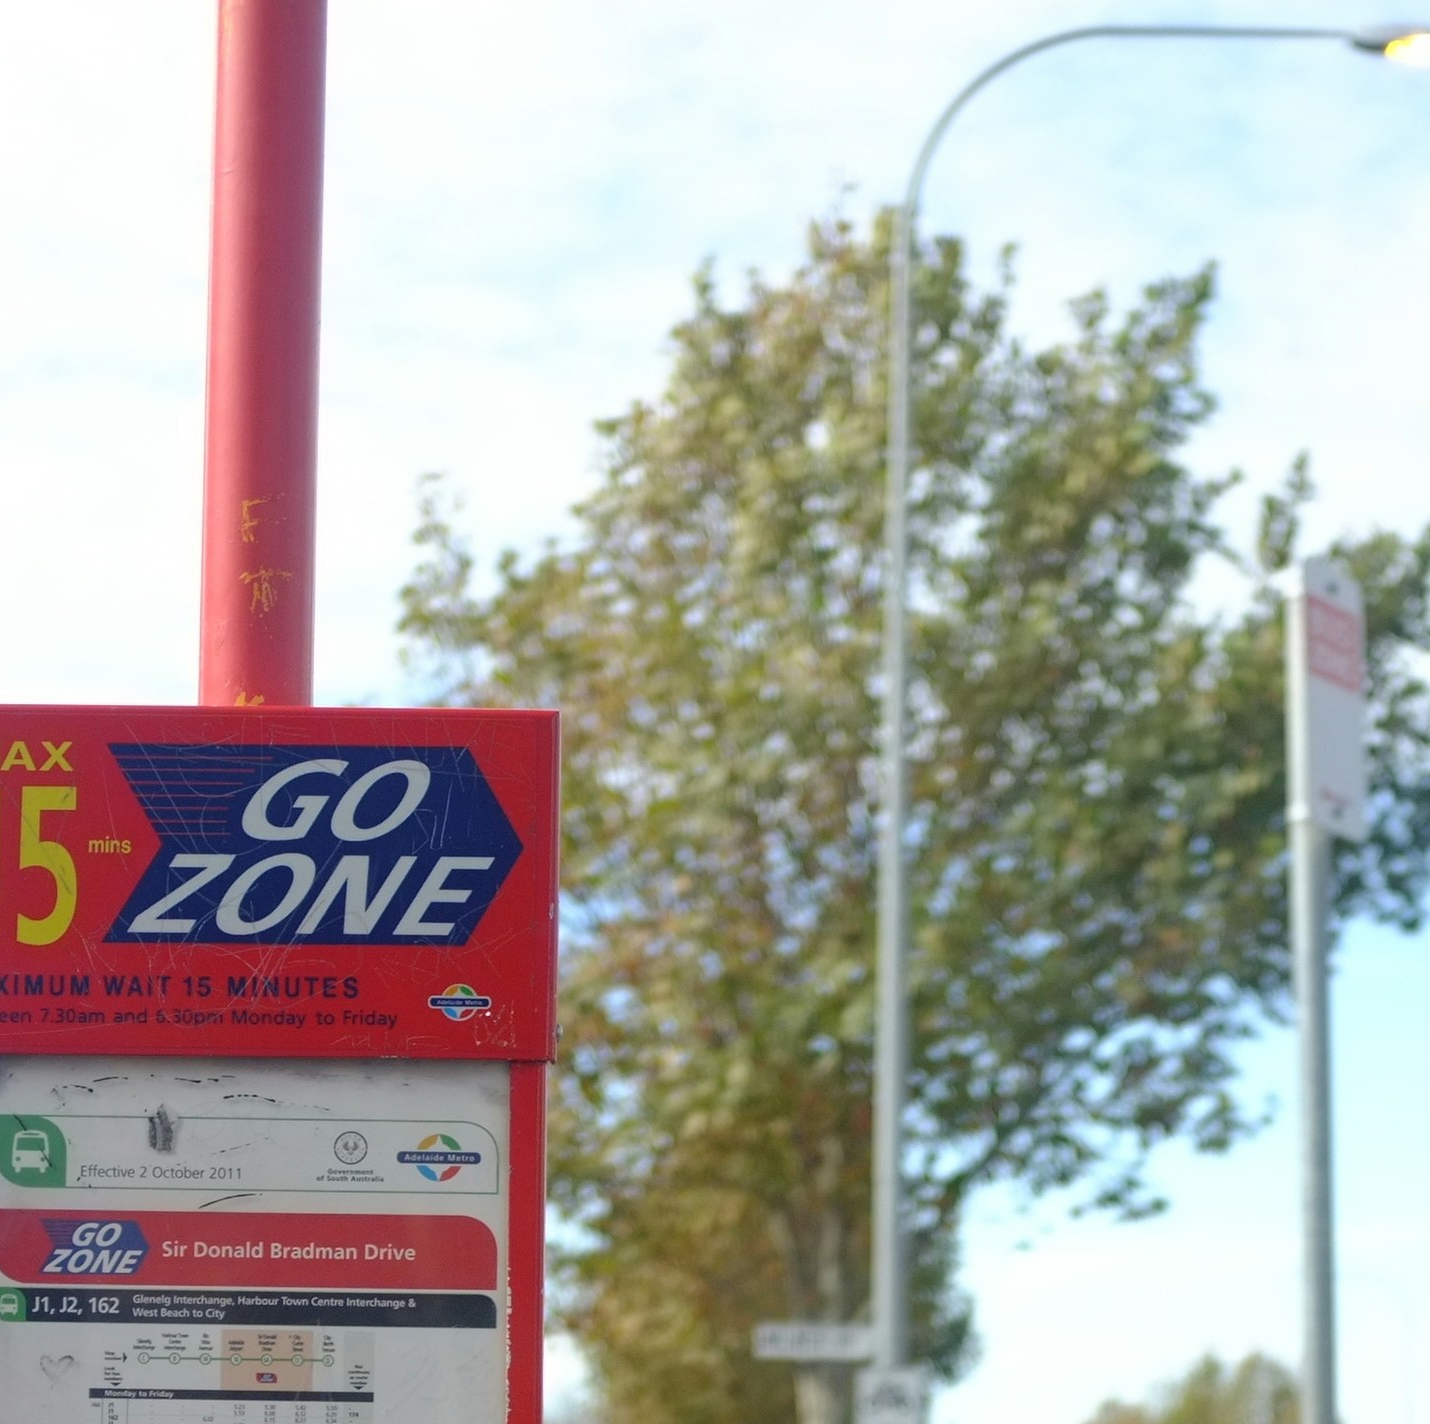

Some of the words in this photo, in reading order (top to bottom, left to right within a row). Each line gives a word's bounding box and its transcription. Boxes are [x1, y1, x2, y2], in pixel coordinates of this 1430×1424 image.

[241, 759, 431, 841] GO
[88, 836, 132, 854] mins
[127, 853, 495, 936] ZONE
[103, 975, 171, 997] WAIT
[183, 975, 212, 997] 15
[227, 976, 359, 998] MINUTES
[40, 1009, 104, 1024] 7.30am
[114, 1009, 147, 1024] and
[231, 1009, 306, 1028] Monday
[316, 1010, 335, 1025] to
[345, 1010, 398, 1029] Friday
[403, 1153, 443, 1162] Adelaide
[447, 1153, 475, 1163] Metro
[80, 1165, 134, 1179] Effective
[139, 1166, 148, 1179] 2
[153, 1166, 206, 1180] October
[211, 1167, 243, 1180] 2011
[72, 1222, 122, 1247] GO
[162, 1241, 187, 1259] Sir
[194, 1241, 263, 1259] Donald
[270, 1242, 357, 1260] Bradman
[364, 1242, 416, 1260] Drive
[42, 1249, 143, 1274] ZONE
[31, 1297, 54, 1315] J1,
[59, 1297, 82, 1315] J2,
[89, 1297, 119, 1313] 162
[132, 1295, 171, 1307] Glenelg
[174, 1295, 235, 1308] Interchange,
[237, 1296, 279, 1306] Harbour
[281, 1296, 308, 1306] Town
[311, 1297, 344, 1307] Centre
[346, 1297, 406, 1309] Interchange
[408, 1298, 416, 1307] &
[132, 1308, 158, 1317] West
[160, 1308, 189, 1317] Beach
[192, 1308, 203, 1317] to
[206, 1309, 225, 1320] City
[105, 1390, 137, 1399] Monday
[149, 1390, 174, 1399] Friday
